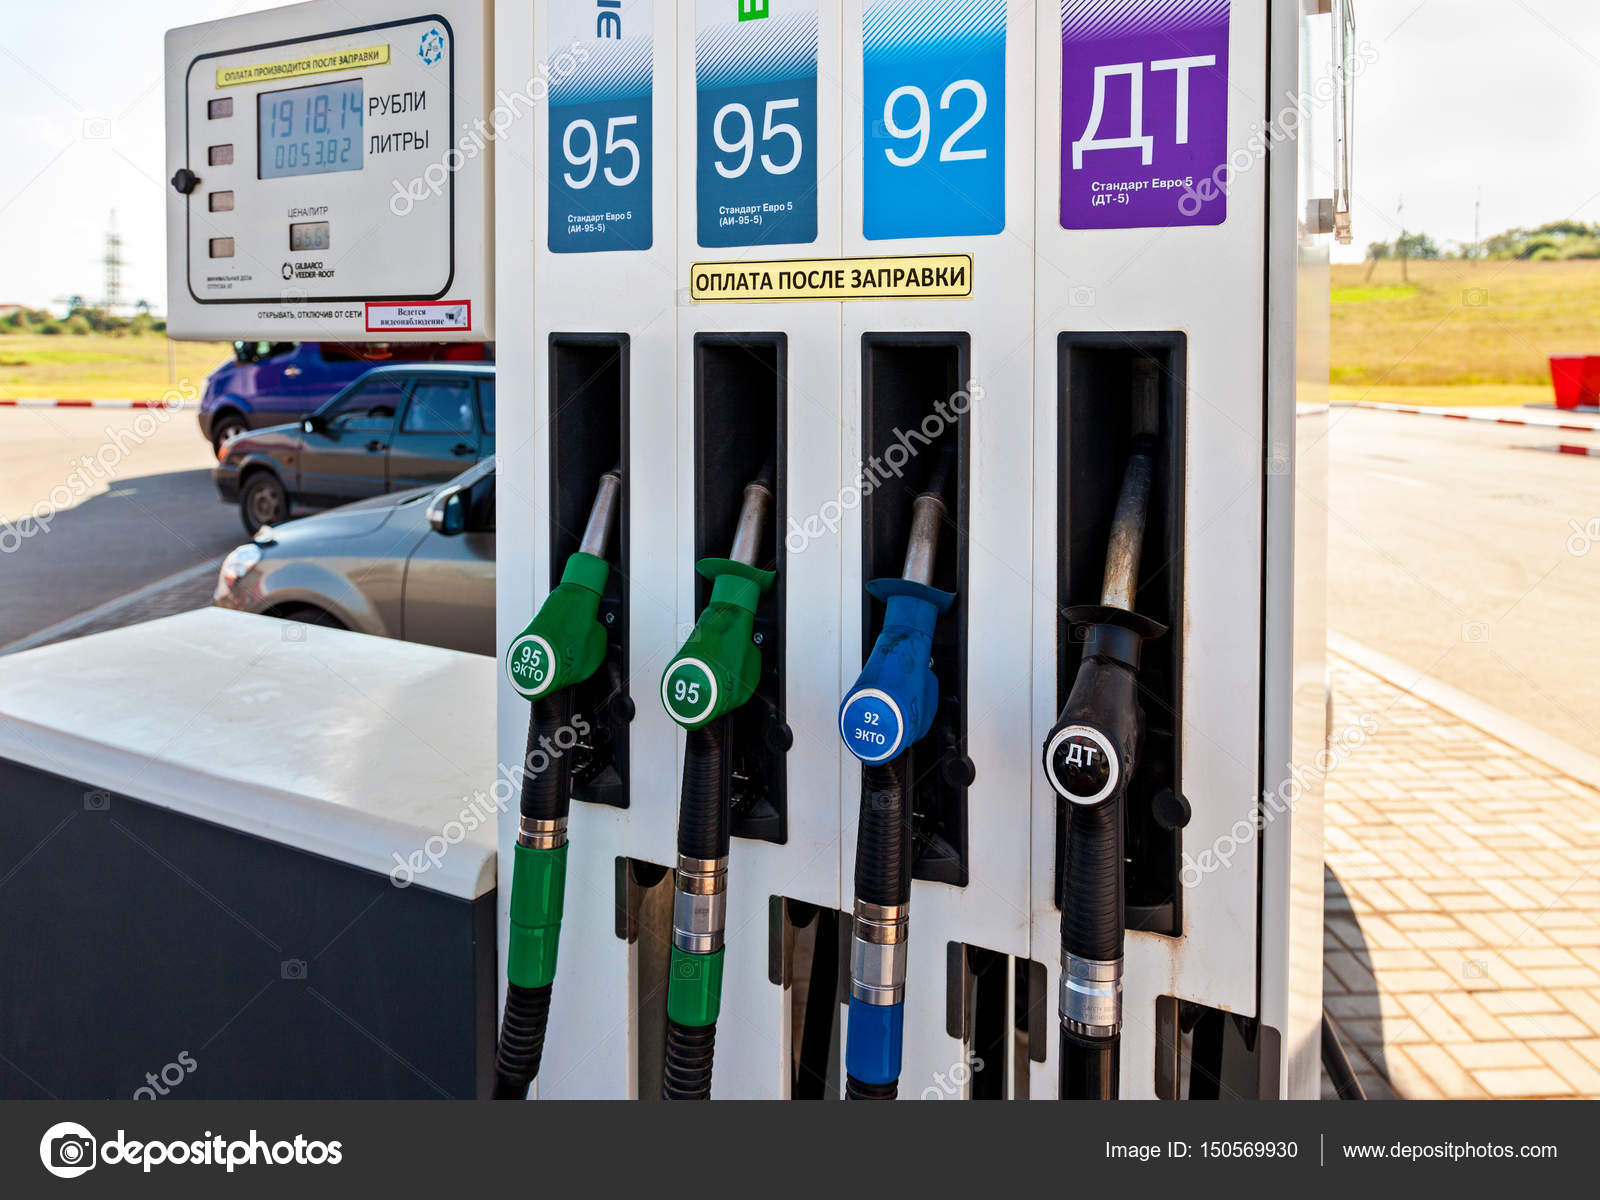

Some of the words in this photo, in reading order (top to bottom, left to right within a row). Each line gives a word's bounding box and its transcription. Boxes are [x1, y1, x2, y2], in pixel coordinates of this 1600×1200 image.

[224, 69, 253, 82] ОПЛАТА
[253, 61, 311, 77] ПРОИЗВОДИТСЯ
[312, 56, 337, 69] ПОСЛЕ
[338, 50, 379, 65] ЗАПРАВКИ
[369, 90, 426, 117] РУБЛИ
[1072, 55, 1216, 170] ДТ
[883, 79, 988, 167] 92
[369, 130, 429, 155] ЛИТРЫ
[713, 97, 802, 179] 95
[562, 115, 641, 189] 95
[1091, 180, 1149, 194] Стандарт
[1152, 178, 1182, 191] Евро
[1184, 176, 1193, 187] 5
[1091, 193, 1130, 206] (ДТ-5)
[568, 212, 604, 224] Стандарт
[605, 212, 625, 222] Евро
[626, 211, 632, 220] 5
[719, 205, 761, 217] Стандарт
[763, 203, 784, 214] Евро
[787, 202, 793, 211] 5
[568, 223, 606, 234] (АИ-95-5)
[719, 215, 763, 227] (АИ-95-5)
[295, 262, 323, 270] GILBARCO
[295, 270, 335, 279] VEEDER-ROOT
[695, 272, 773, 292] ОПЛАТА
[778, 269, 844, 290] ПОСЛЕ
[850, 266, 966, 288] ЗАПРАВКИ
[257, 311, 296, 319] ОТКРЫВАТЬ,
[297, 310, 333, 319] ОТКЛЮЧИВ
[334, 310, 343, 318] ОТ
[344, 310, 362, 318] СЕТИ
[398, 308, 426, 316] Ведется
[380, 317, 445, 326] видеонаблюдение
[520, 646, 542, 667] 95
[512, 661, 544, 682] ЭКТО
[674, 679, 700, 703] 95
[864, 711, 879, 726] 92
[854, 728, 885, 745] ЭКТО
[1065, 743, 1097, 767] ДТ
